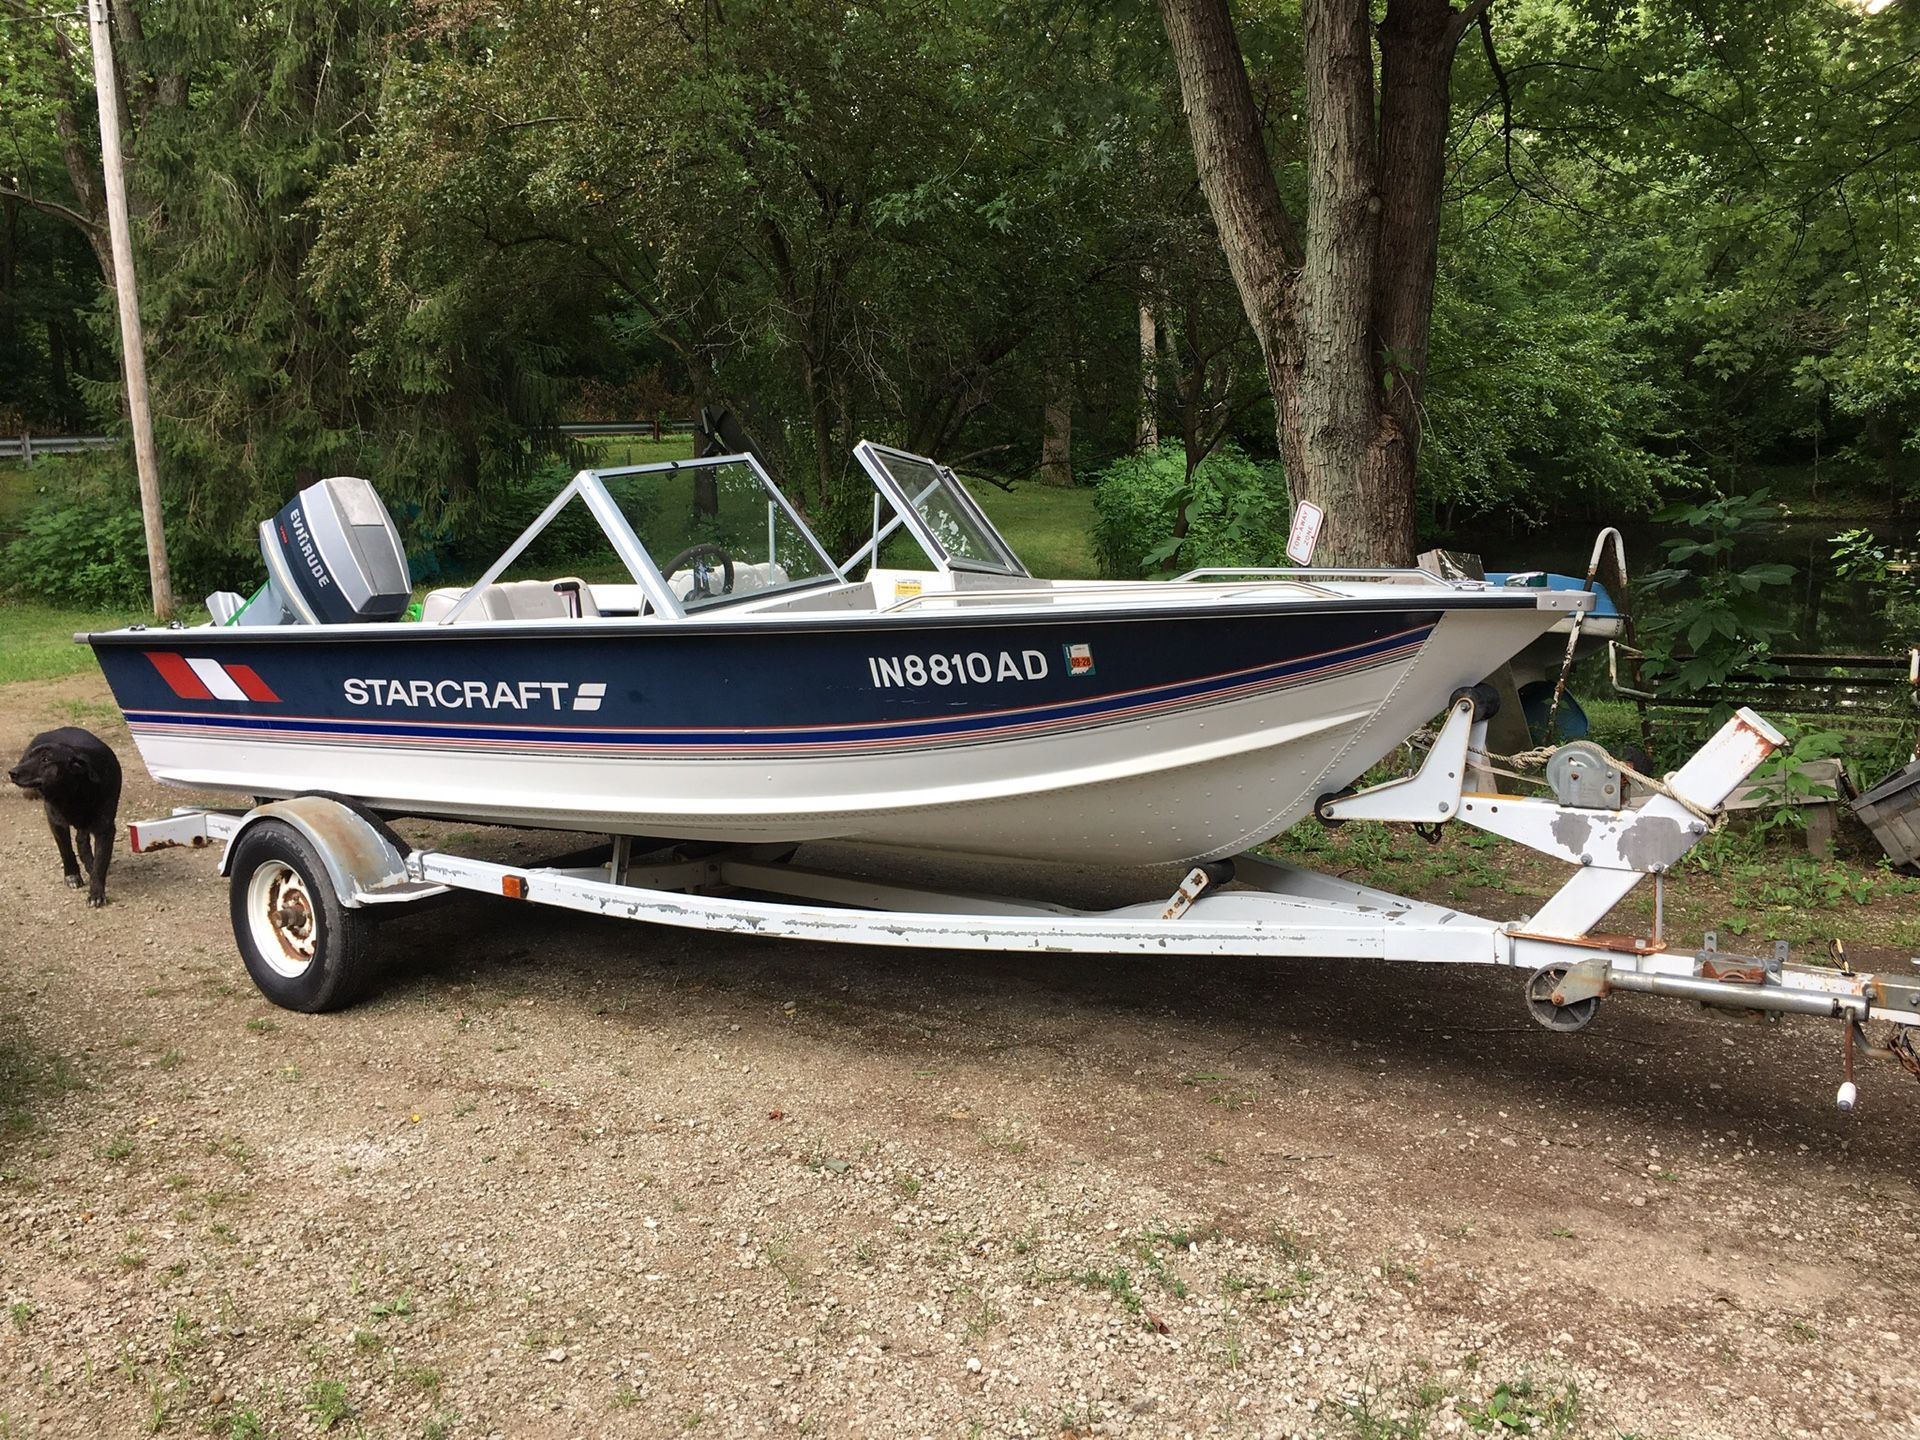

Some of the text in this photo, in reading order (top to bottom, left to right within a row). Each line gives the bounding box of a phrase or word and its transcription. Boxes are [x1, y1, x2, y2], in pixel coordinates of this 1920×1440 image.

[290, 508, 330, 588] EVINRUDE
[1293, 510, 1308, 550] TOW-AWAY
[1304, 525, 1314, 546] ZONE
[868, 649, 1049, 688] IN8810AD
[343, 678, 569, 711] STARCRAFT
